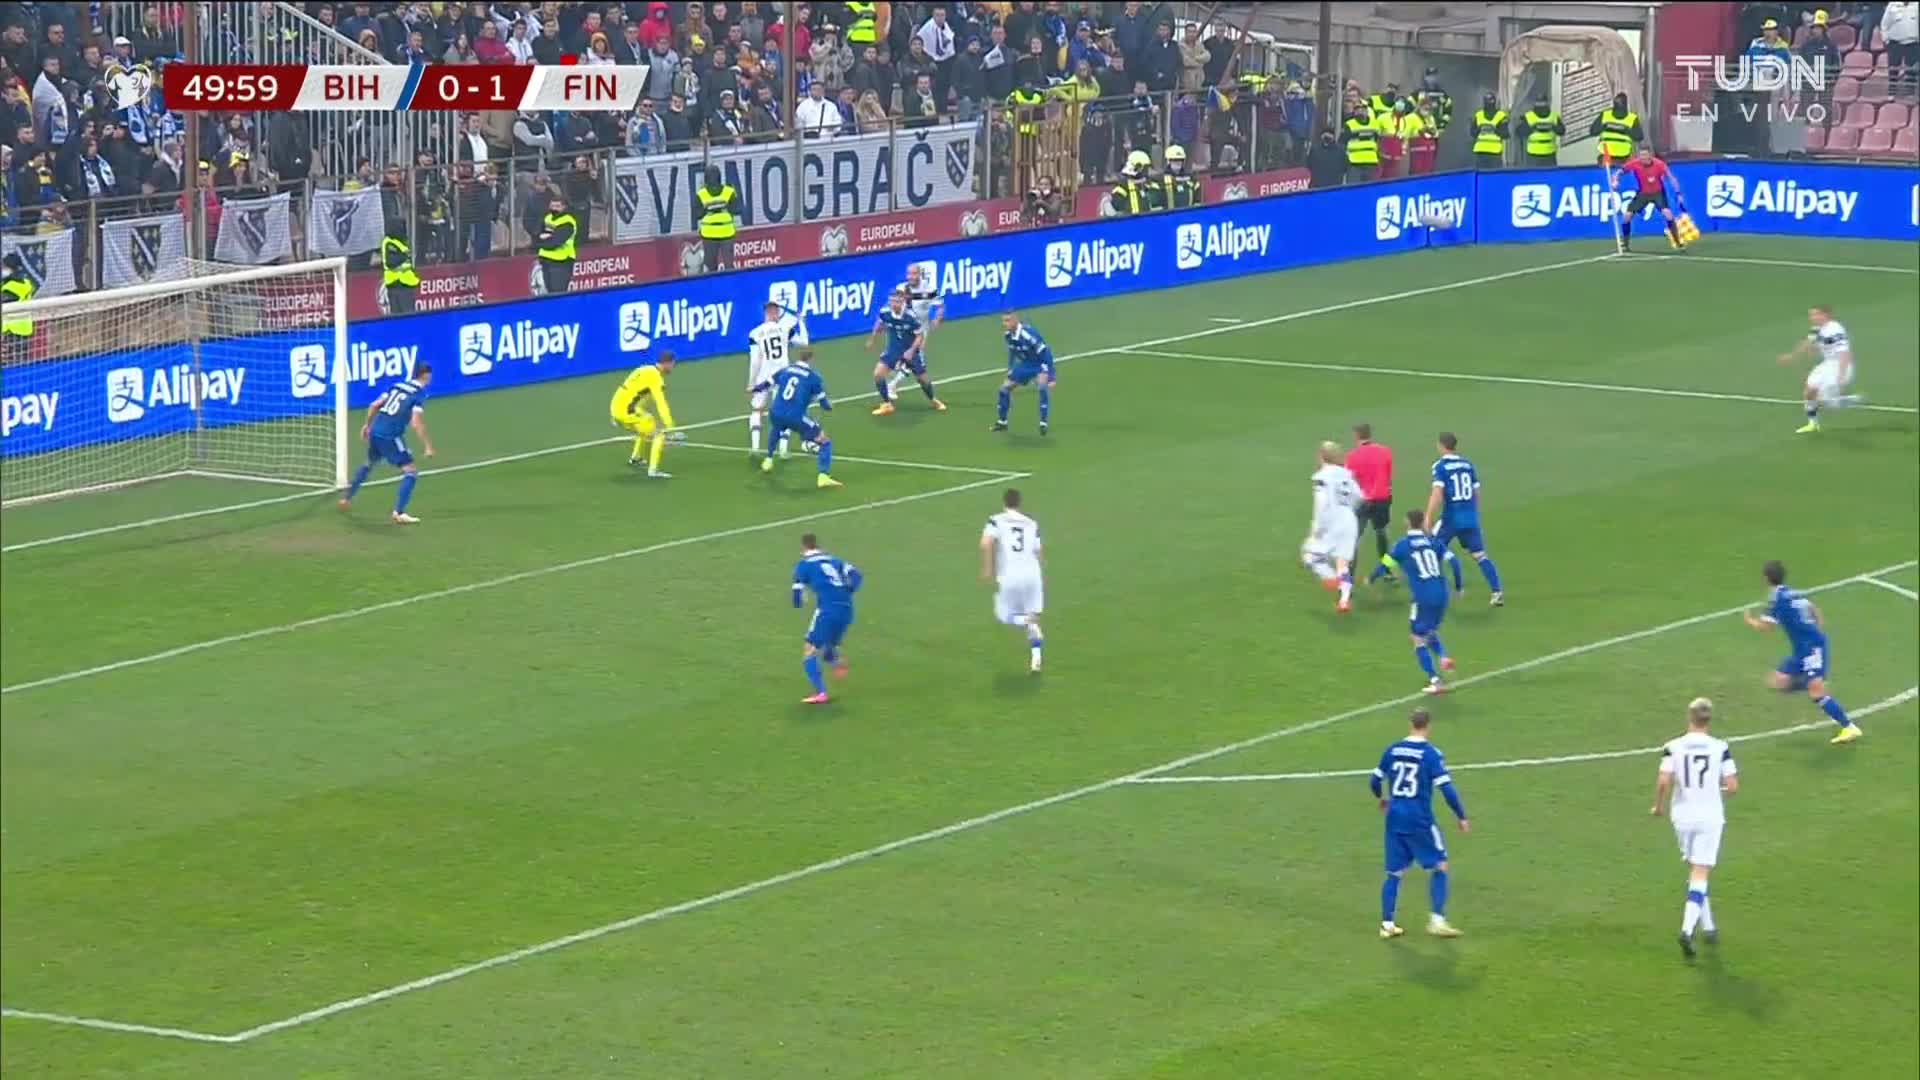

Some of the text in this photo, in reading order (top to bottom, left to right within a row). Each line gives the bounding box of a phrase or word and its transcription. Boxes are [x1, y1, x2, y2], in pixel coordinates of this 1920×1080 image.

[647, 130, 933, 234] VNOGRAČ
[1556, 184, 1654, 222] Alipa
[1748, 180, 1858, 222] Alipay
[733, 239, 776, 256] ROPEAN
[860, 222, 916, 241] EUROPEAN
[1204, 220, 1271, 260] Alipay
[572, 256, 630, 277] EUROPEAN
[1074, 239, 1145, 280] Alipay
[419, 275, 480, 295] EUROPEAN
[941, 257, 1012, 299] Alipay
[801, 277, 875, 320] Alipay
[654, 298, 733, 341] Alipay
[496, 319, 581, 364] Alipay
[763, 337, 783, 361] 15
[148, 363, 246, 411] Alipay
[379, 389, 407, 416] 16
[782, 376, 800, 401] 6
[1449, 472, 1474, 501] 18
[1011, 526, 1025, 552] 3
[1411, 548, 1441, 580] 10
[1391, 760, 1420, 798] 23
[1684, 754, 1710, 789] 17
